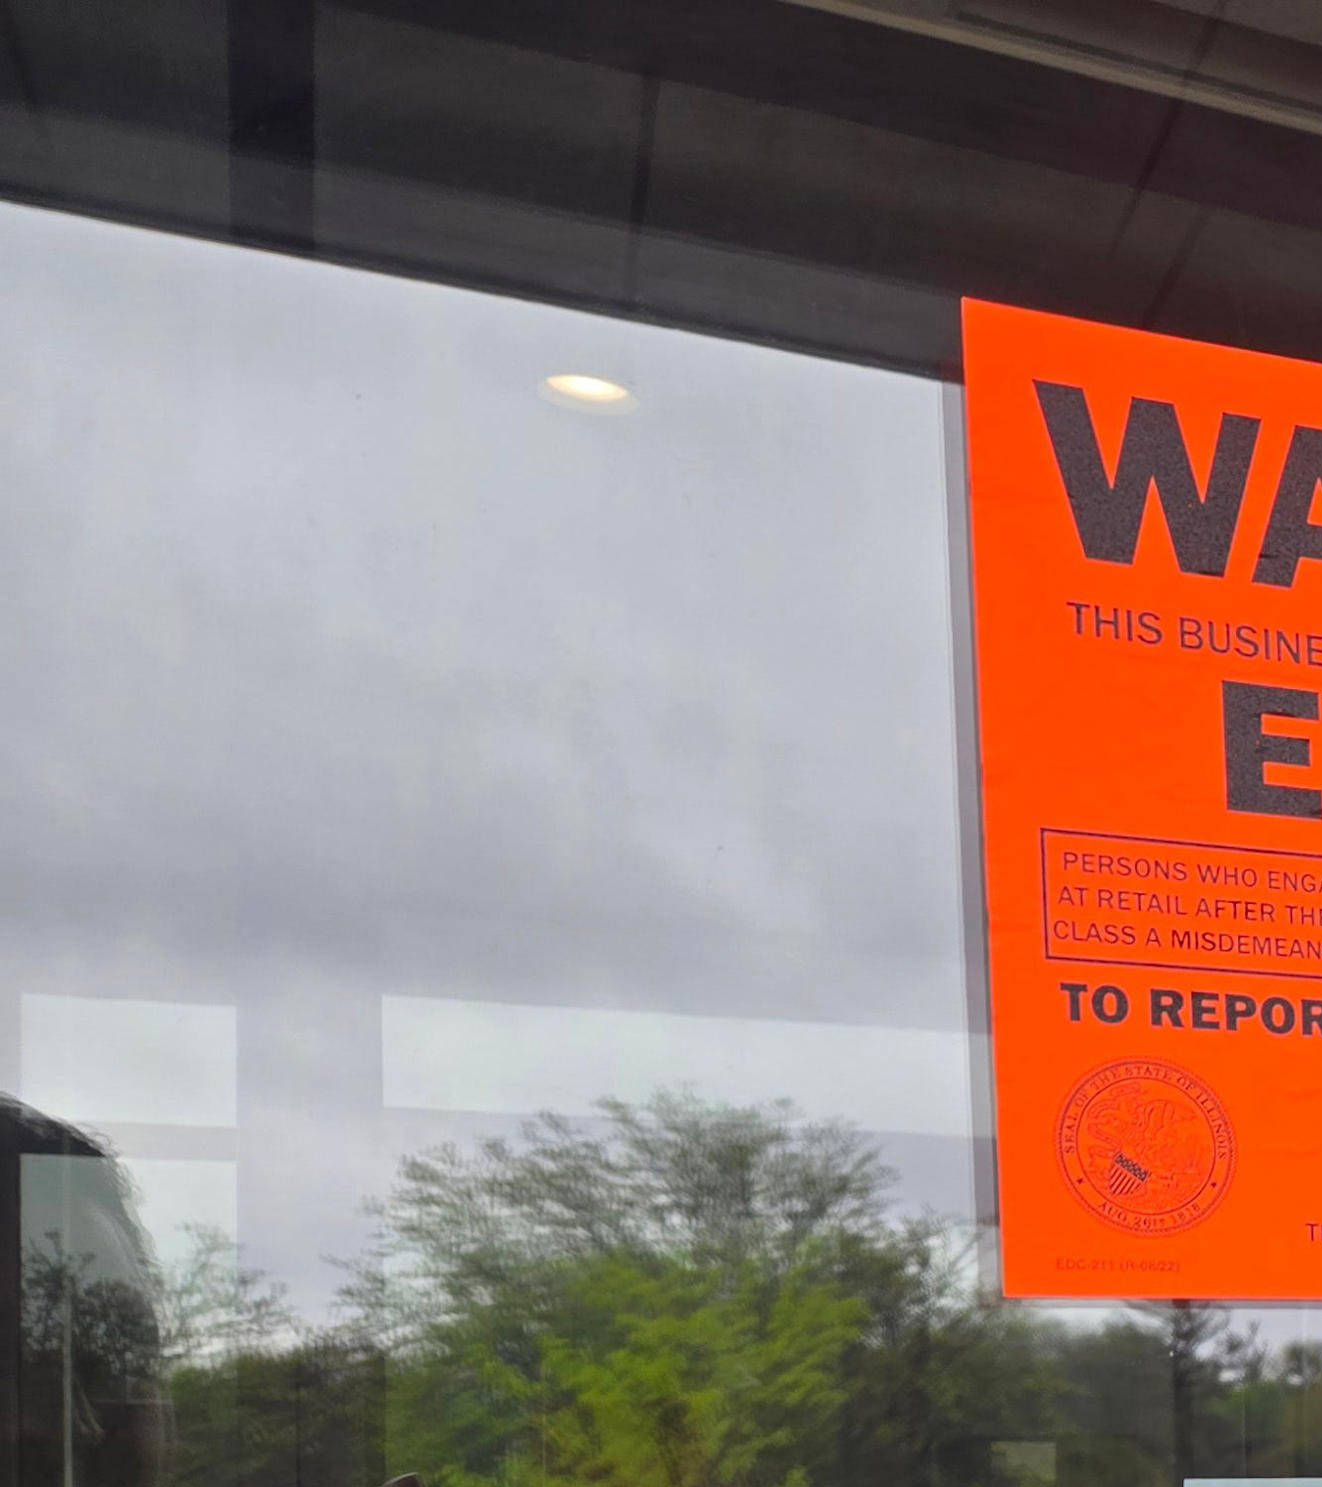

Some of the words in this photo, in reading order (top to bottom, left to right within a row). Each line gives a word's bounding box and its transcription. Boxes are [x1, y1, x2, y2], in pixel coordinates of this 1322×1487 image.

[1066, 601, 1163, 645] THIS
[1063, 851, 1188, 881] PERSONS
[1197, 863, 1258, 888] WHO
[1058, 886, 1087, 906] AT
[1097, 888, 1188, 916] RETAIL
[1196, 897, 1275, 922] AFTER
[1053, 920, 1136, 945] CLASS
[1146, 927, 1161, 947] A
[1059, 981, 1129, 1024] TO
